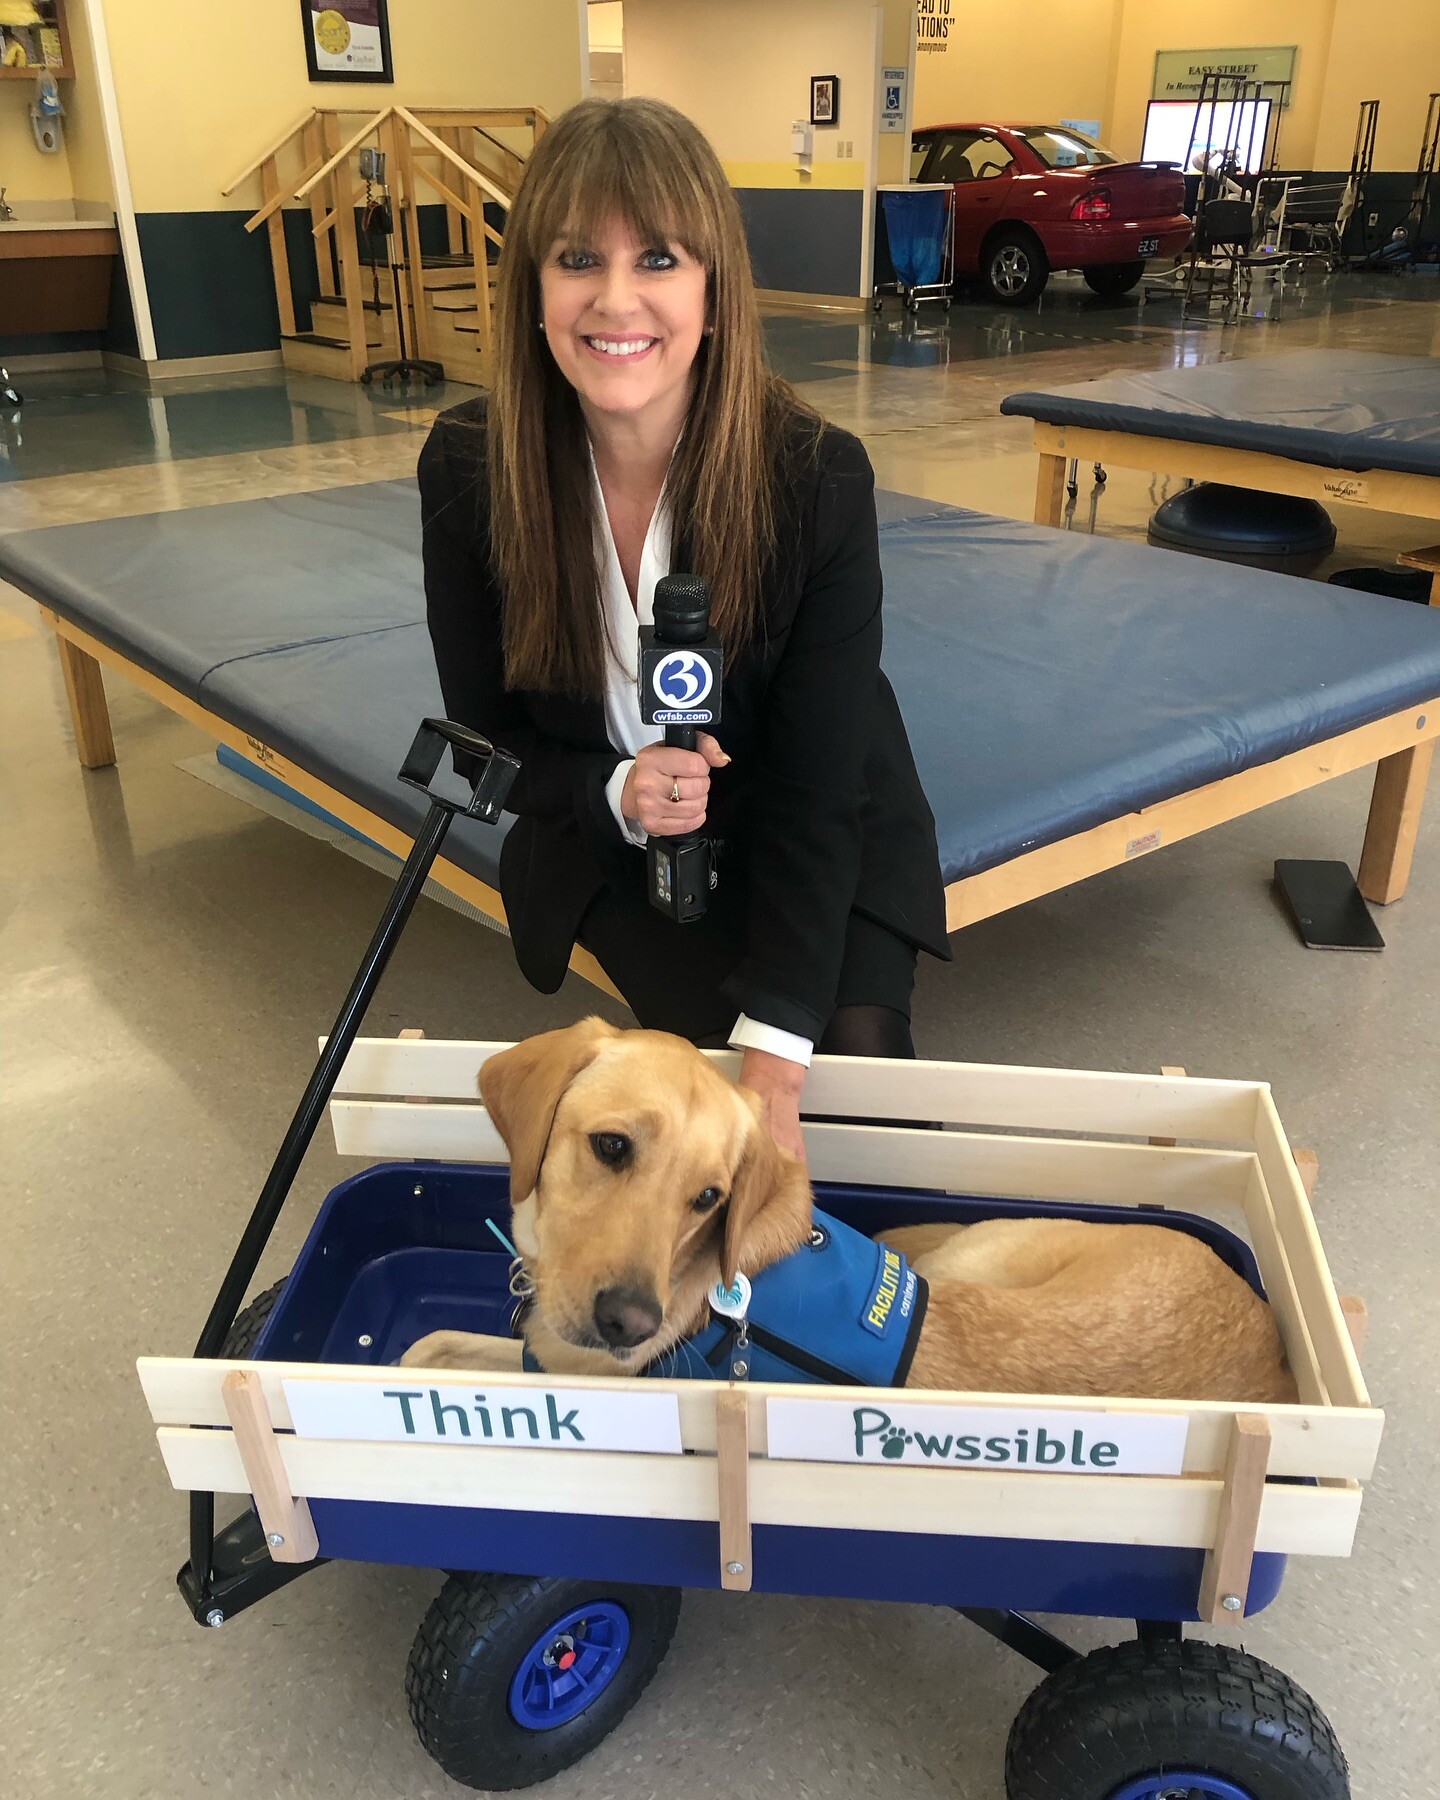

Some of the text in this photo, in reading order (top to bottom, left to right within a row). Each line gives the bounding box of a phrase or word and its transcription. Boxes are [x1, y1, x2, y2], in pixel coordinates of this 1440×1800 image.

[1188, 64, 1258, 75] EASY STREET
[1166, 82, 1174, 90] In
[1138, 239, 1159, 252] EZ ST
[667, 658, 699, 702] 3
[657, 711, 708, 721] wfsb.com
[868, 1265, 900, 1329] FACILITY
[382, 1389, 585, 1441] Think
